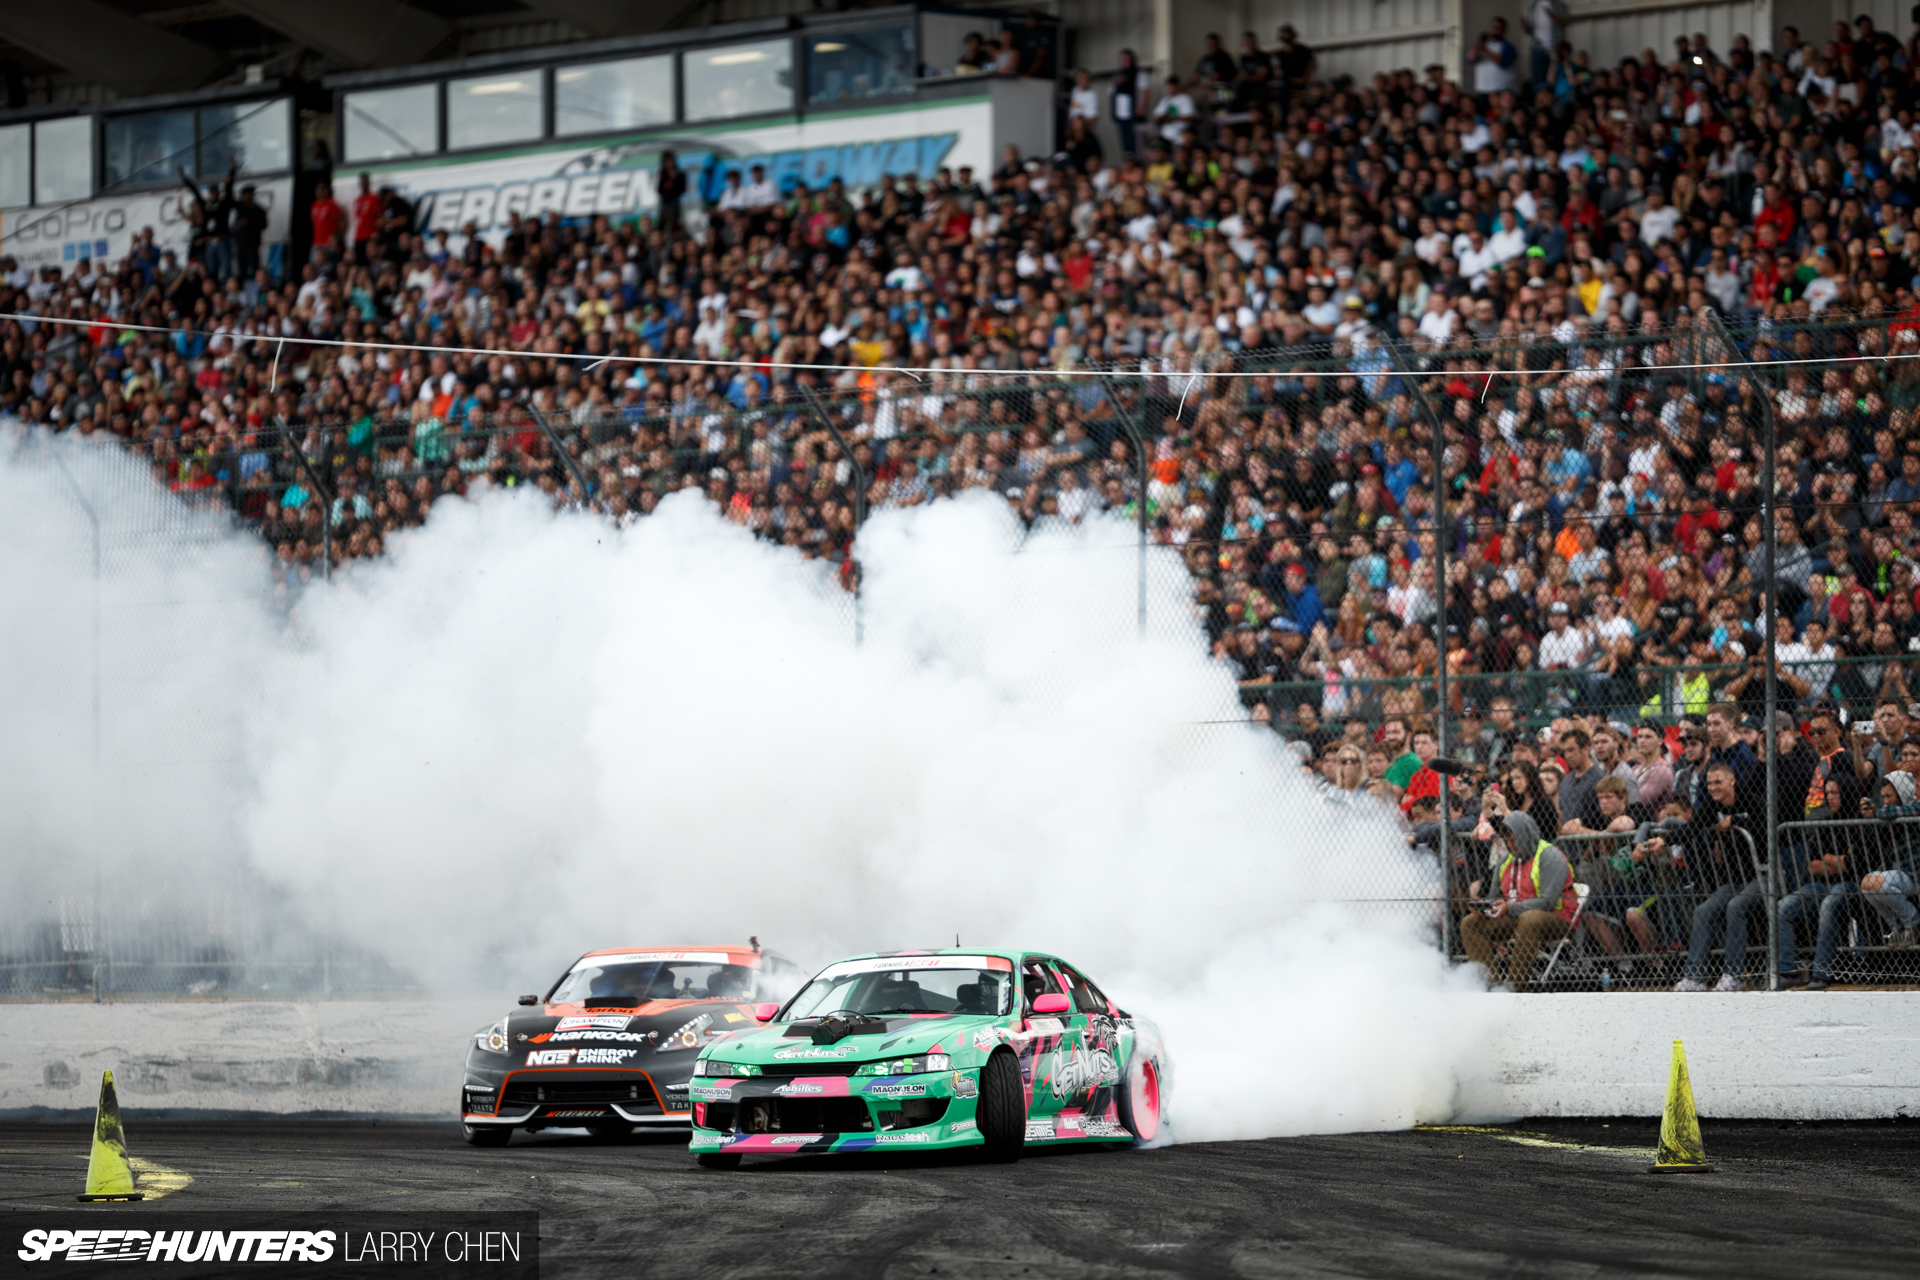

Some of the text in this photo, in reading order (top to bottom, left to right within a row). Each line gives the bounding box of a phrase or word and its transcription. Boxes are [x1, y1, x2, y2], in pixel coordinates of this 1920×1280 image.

[873, 959, 941, 969] FORMULA DRIFT
[563, 1017, 625, 1027] CHAMPION
[526, 1048, 578, 1066] NOS
[577, 1048, 638, 1058] ENERGY
[576, 1055, 623, 1064] DRINK
[693, 1087, 731, 1096] MAGNUSON
[772, 1083, 824, 1094] Achilles
[471, 1104, 494, 1112] TAKATA
[875, 1131, 930, 1143] Racetech
